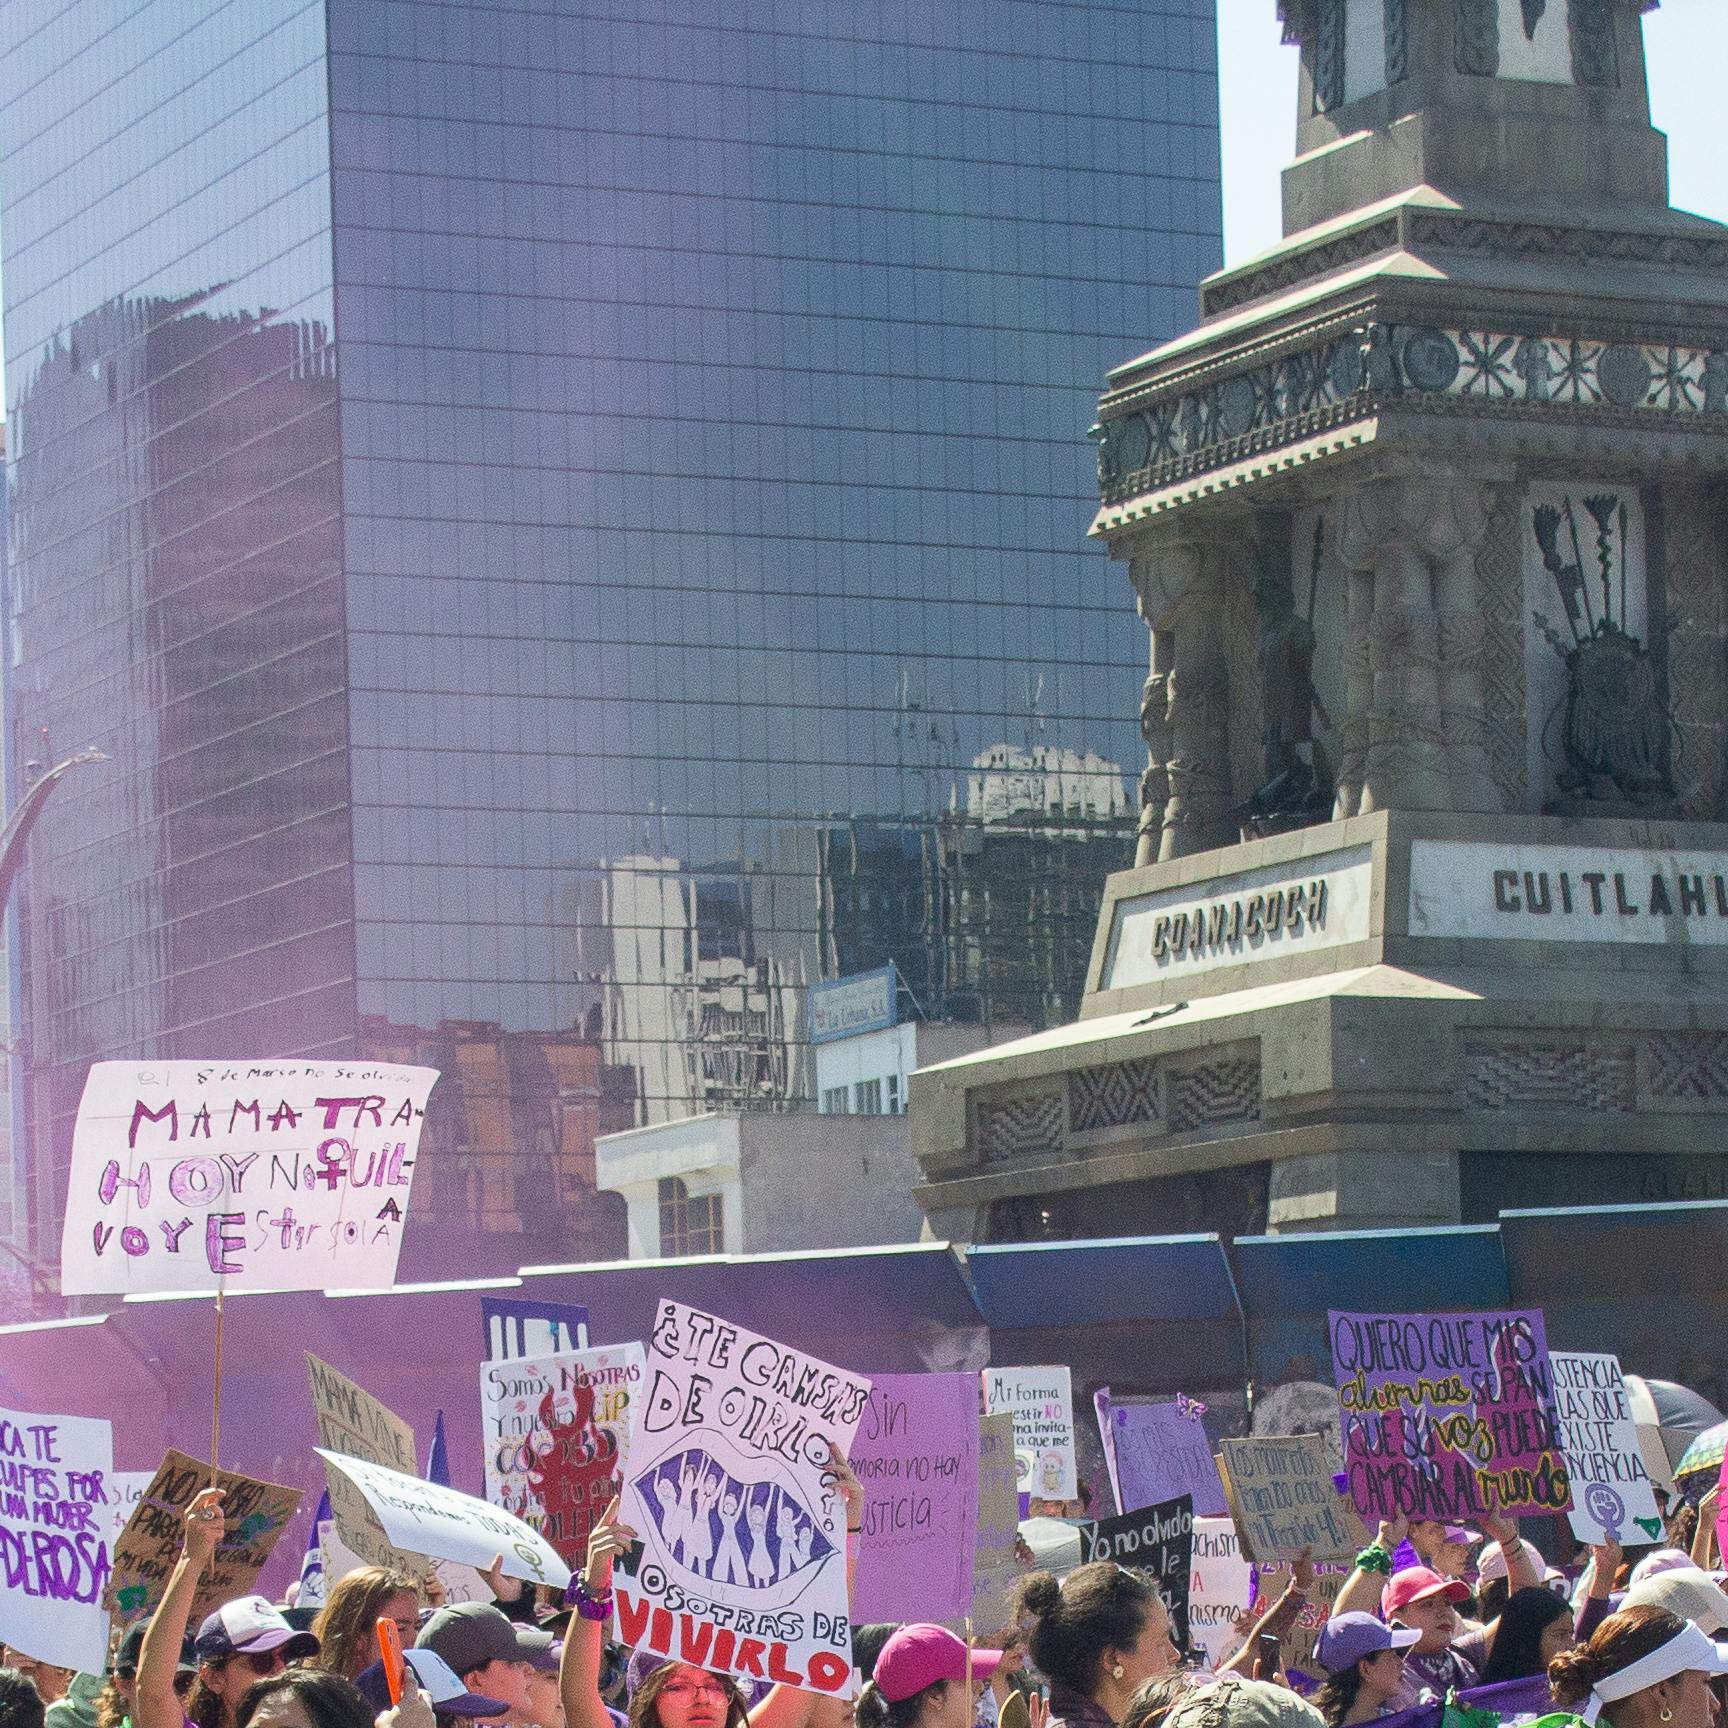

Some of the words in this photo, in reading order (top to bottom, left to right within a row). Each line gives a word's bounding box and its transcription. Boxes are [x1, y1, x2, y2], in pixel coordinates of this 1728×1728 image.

[1151, 878, 1327, 958] COANACOCH
[127, 1098, 303, 1149] MAMA
[97, 1152, 260, 1209] HOY
[93, 1217, 194, 1257] VOY
[1334, 1316, 1426, 1374] QUIERO
[1428, 1318, 1480, 1370] QUE
[1482, 1317, 1537, 1367] MIS
[487, 1368, 554, 1402] Somos
[644, 1369, 713, 1434] DE
[1015, 1385, 1060, 1401] forma
[1472, 1361, 1550, 1405] SEPAN
[1555, 1388, 1590, 1421] LAS
[1592, 1390, 1629, 1422] QUE
[866, 1386, 909, 1442] Sin
[1044, 1404, 1064, 1420] NO
[26, 1424, 61, 1463] TE
[1028, 1435, 1049, 1449] que
[1051, 1435, 1070, 1448] me
[1346, 1413, 1398, 1459] QUE
[1432, 1412, 1495, 1466] voz
[1491, 1406, 1567, 1458] PUEDE
[68, 1470, 111, 1506] POR
[1349, 1460, 1452, 1517] CAMBIAR
[1475, 1450, 1572, 1509] mundo
[33, 1499, 101, 1534] MUJER
[1080, 1521, 1110, 1562] Yo
[1114, 1532, 1140, 1553] no
[1140, 1505, 1193, 1547] olvido
[613, 1587, 852, 1692] VIVIRLO
[812, 1611, 850, 1648] DE
